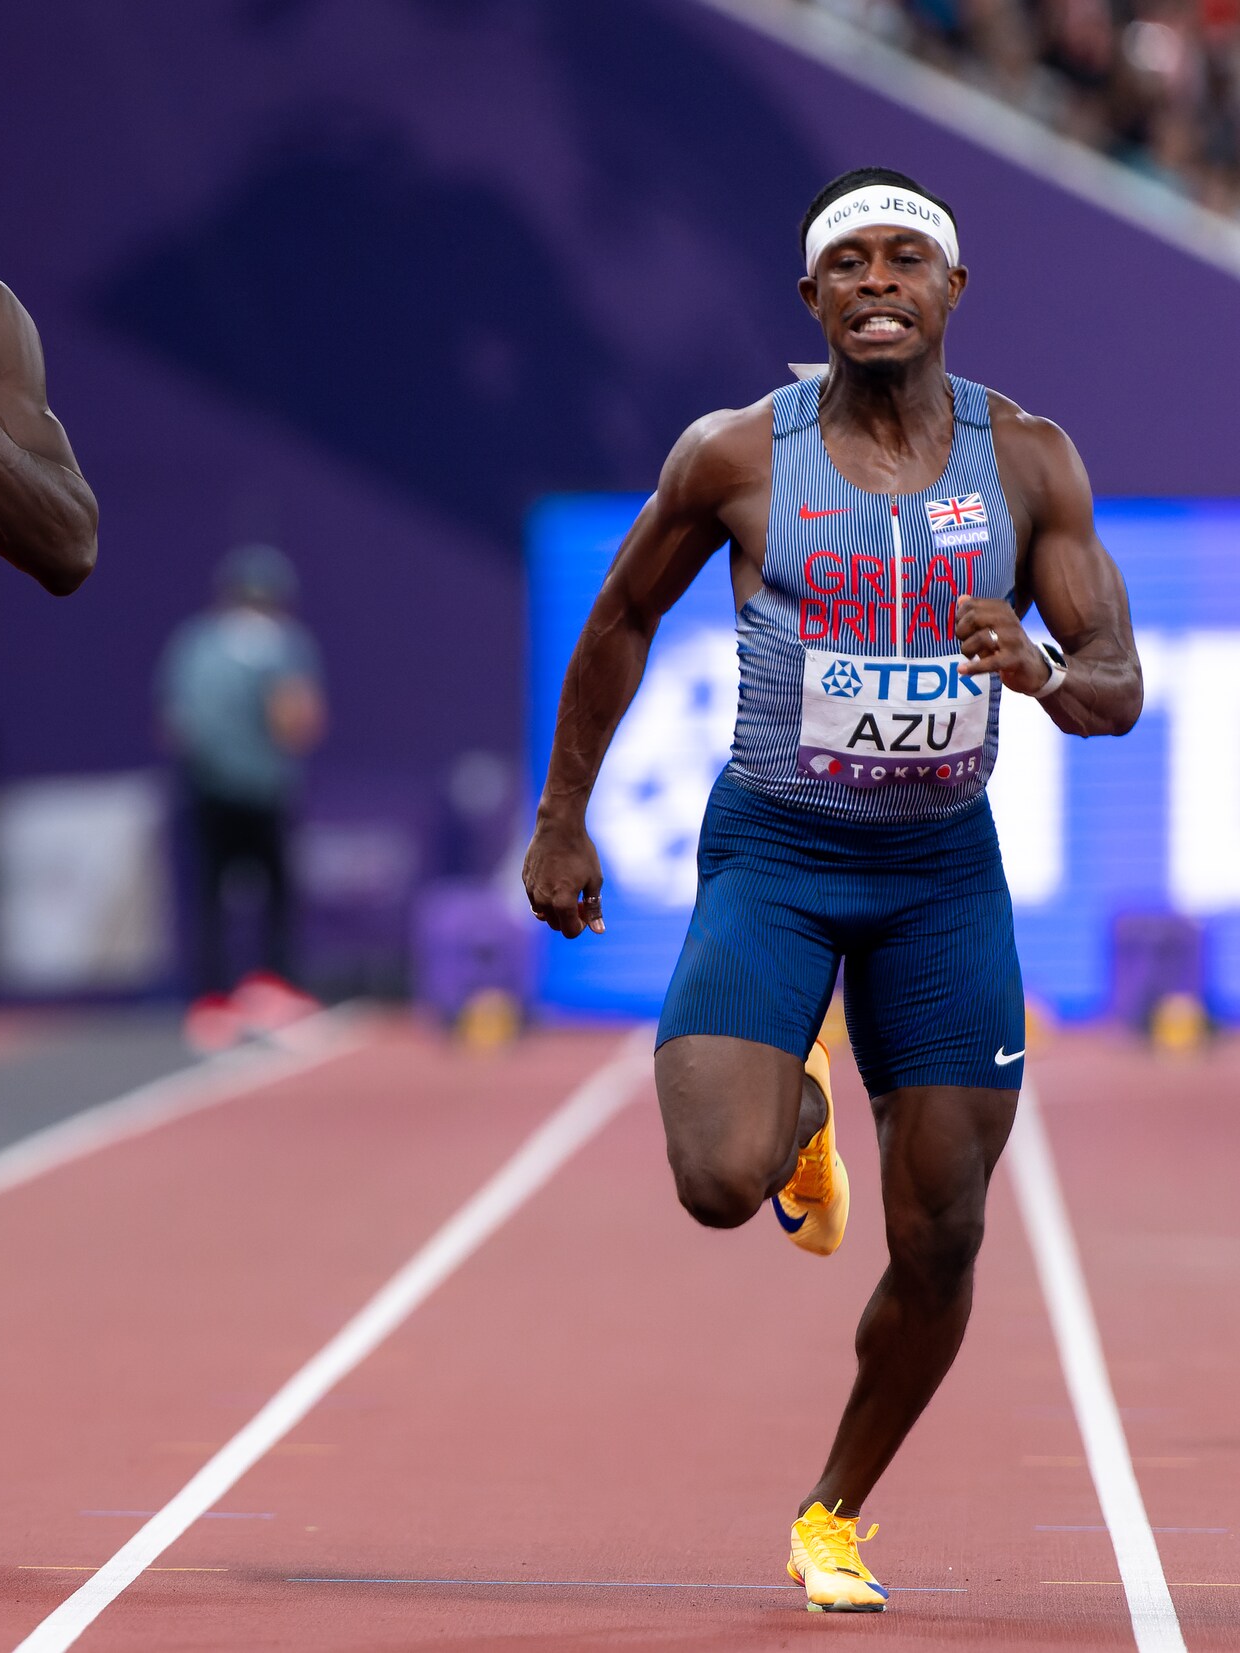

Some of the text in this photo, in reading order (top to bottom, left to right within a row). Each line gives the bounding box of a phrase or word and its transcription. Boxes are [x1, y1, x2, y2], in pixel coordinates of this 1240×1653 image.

[826, 197, 941, 228] 100% JESUS
[934, 530, 989, 548] Novuna
[804, 550, 982, 599] GREAT
[799, 598, 956, 644] BRITAI
[863, 661, 983, 701] TDK
[846, 712, 957, 752] AZU
